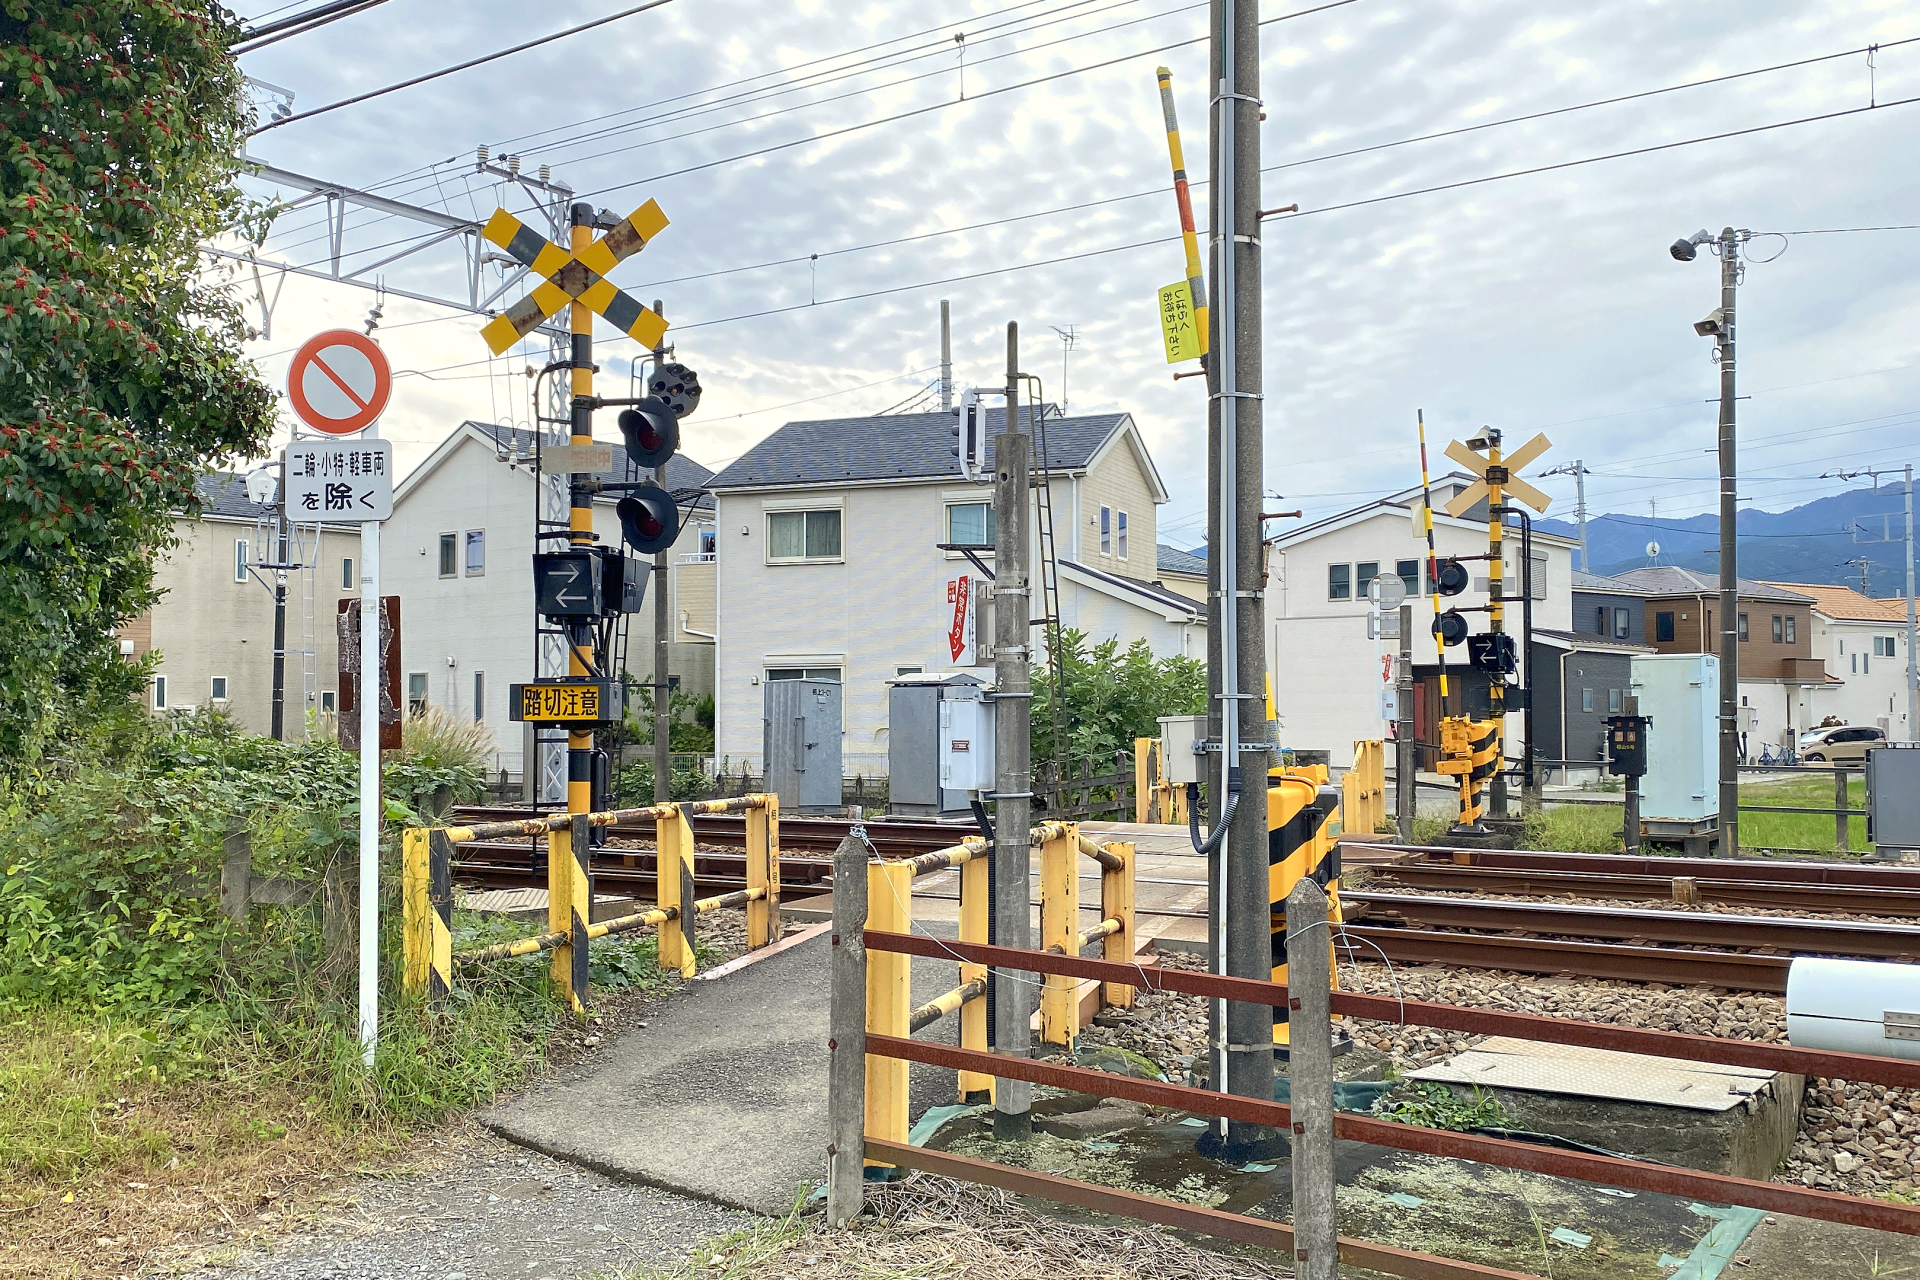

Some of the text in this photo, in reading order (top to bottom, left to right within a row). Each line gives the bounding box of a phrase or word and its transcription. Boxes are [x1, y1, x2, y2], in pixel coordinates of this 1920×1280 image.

[1163, 291, 1180, 356] お待ち下さい
[1174, 288, 1190, 331] しばらく
[302, 482, 375, 511] を除く
[524, 688, 598, 717] 踏切注意
